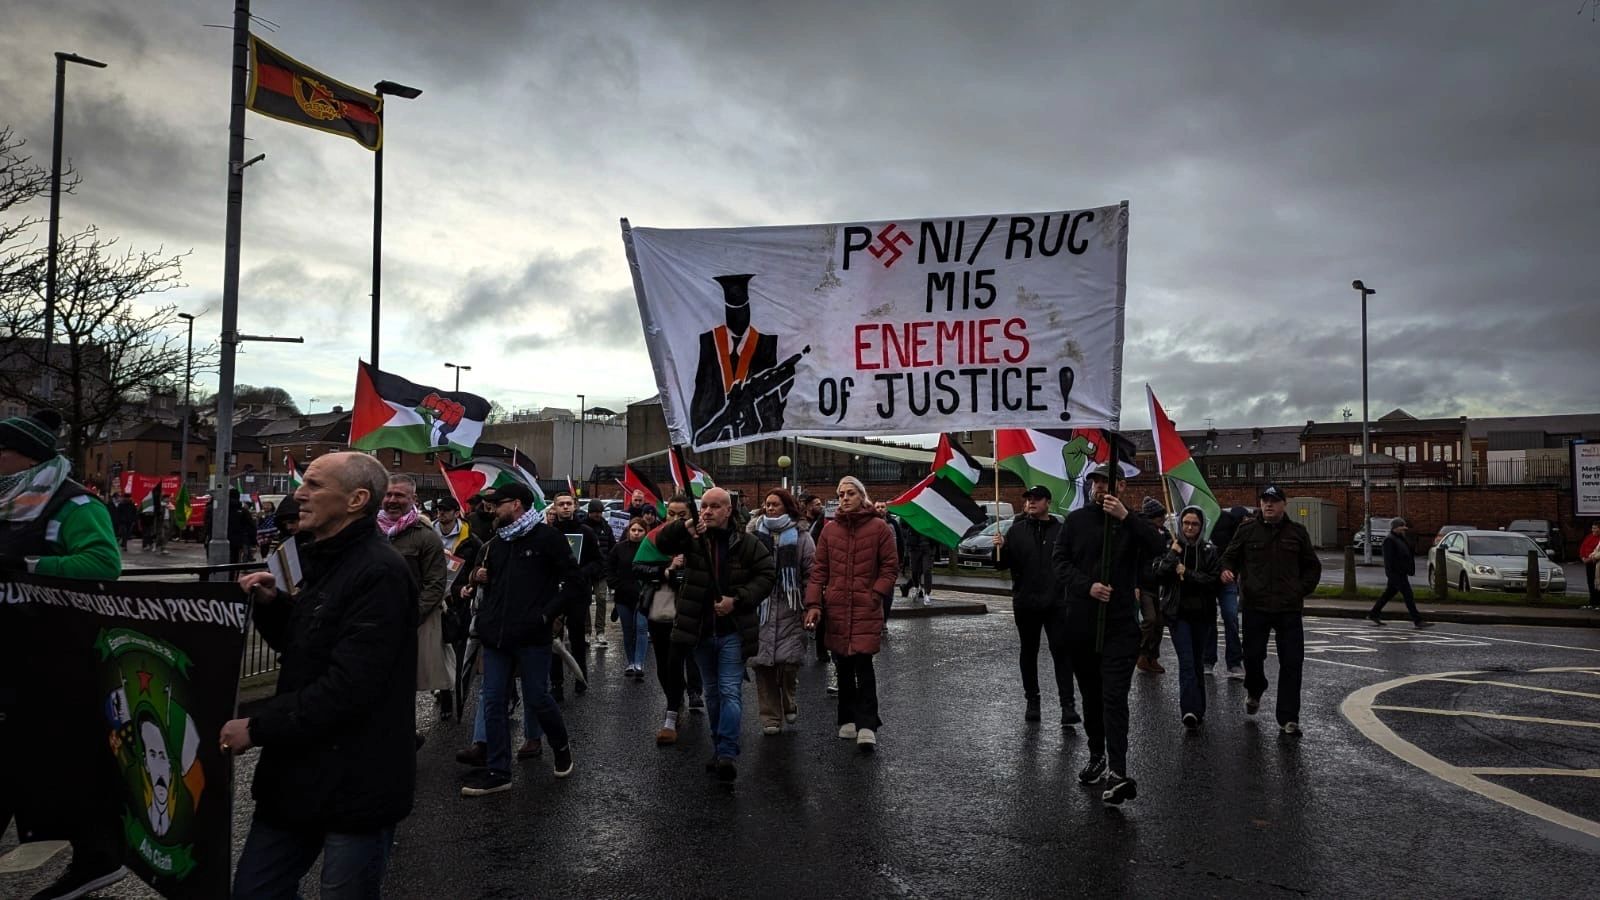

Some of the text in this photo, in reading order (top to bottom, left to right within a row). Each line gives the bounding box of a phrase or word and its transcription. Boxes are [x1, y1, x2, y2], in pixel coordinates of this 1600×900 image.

[926, 269, 997, 313] MI5
[855, 317, 1030, 370] ENEMIES
[63, 589, 169, 621] REPUBLICAN
[163, 598, 249, 635] PRISONE
